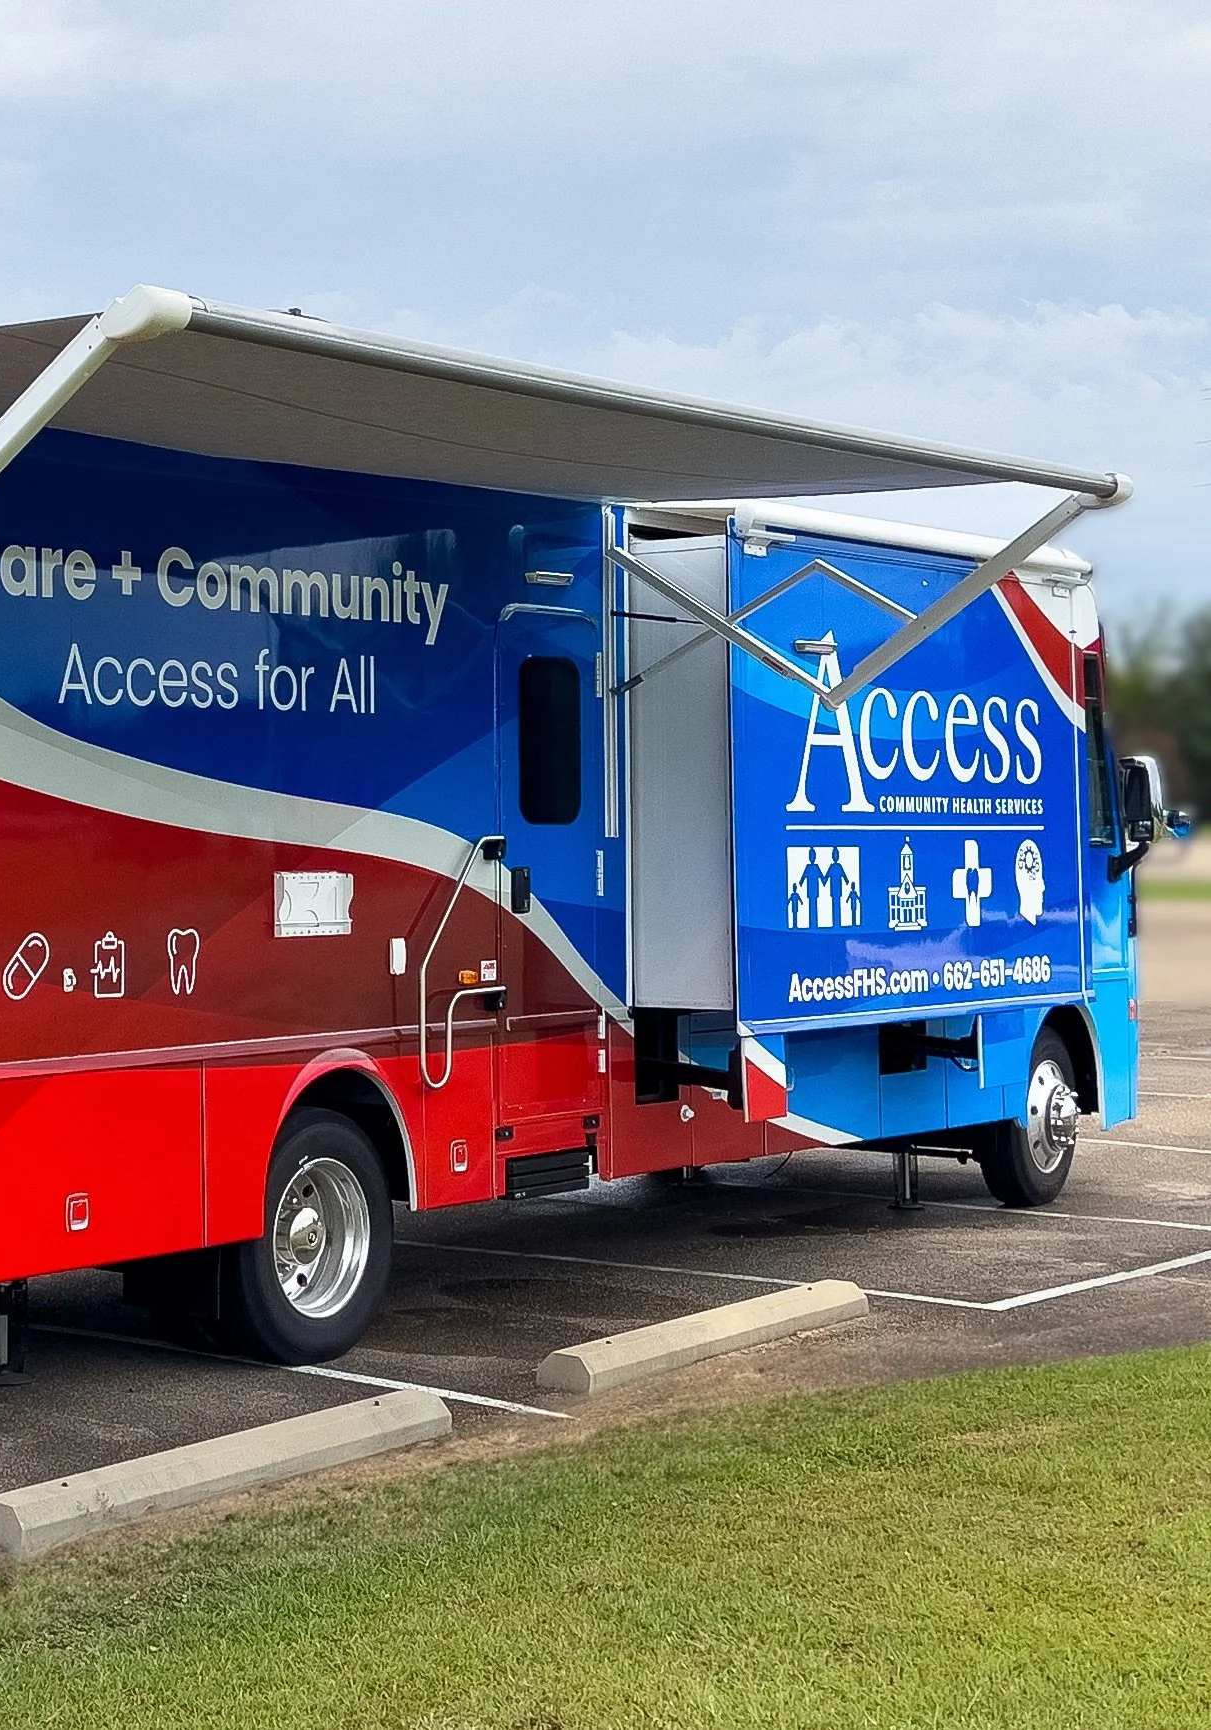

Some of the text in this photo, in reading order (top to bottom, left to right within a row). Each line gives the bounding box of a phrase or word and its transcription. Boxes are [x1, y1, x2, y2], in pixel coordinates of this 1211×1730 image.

[112, 550, 142, 596] +
[156, 546, 449, 646] Community
[58, 643, 376, 714] Access for All
[785, 629, 1043, 813] Access
[878, 796, 1044, 816] COMMUNITY HEALTH SERVICES
[788, 966, 929, 1003] AccessFHS.com
[943, 955, 1051, 991] 662-651-4686
